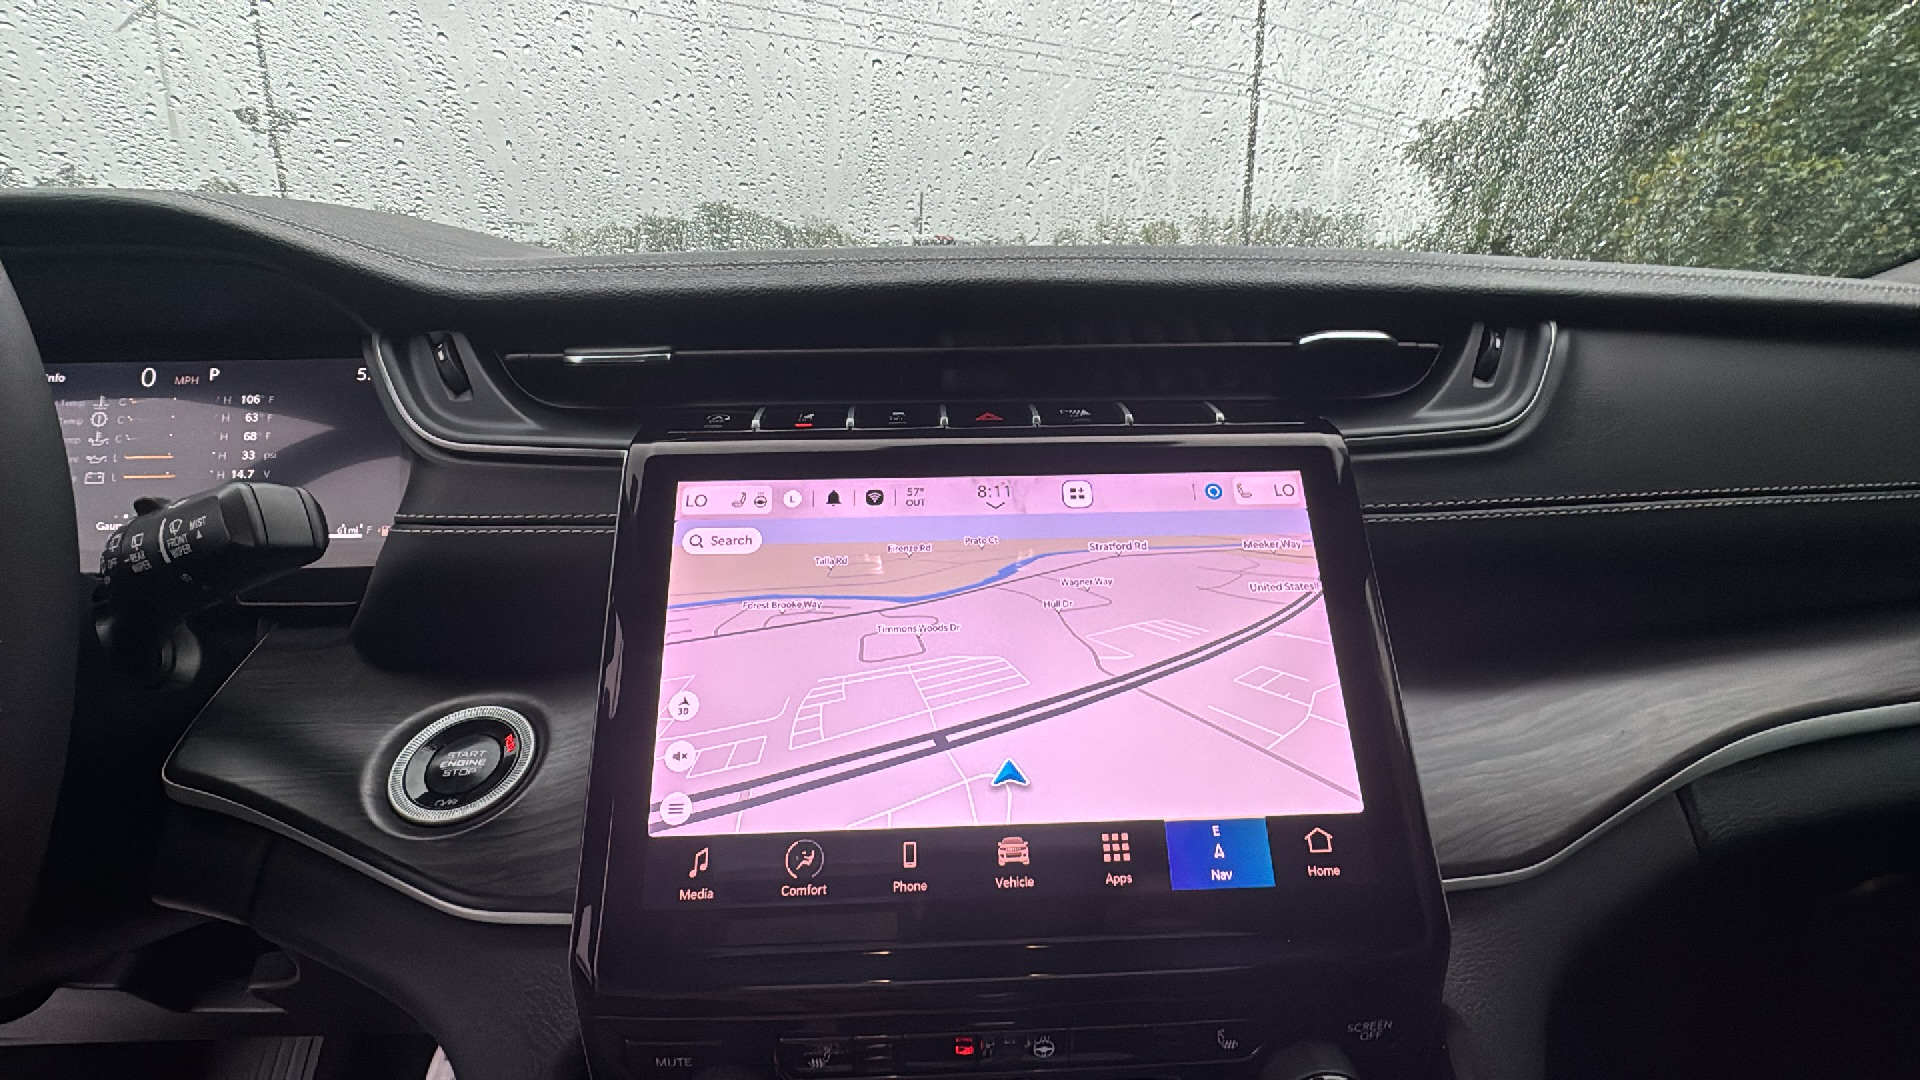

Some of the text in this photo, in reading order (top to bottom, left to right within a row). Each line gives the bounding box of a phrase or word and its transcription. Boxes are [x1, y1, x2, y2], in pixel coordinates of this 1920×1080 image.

[141, 367, 157, 388] 0
[209, 367, 221, 381] P
[174, 376, 200, 385] MPH
[241, 450, 255, 460] 33
[231, 469, 254, 479] 14.7
[977, 484, 1010, 498] 8:11
[1273, 483, 1295, 497] LO
[685, 493, 709, 508] LO
[905, 498, 926, 507] OUT
[189, 515, 207, 531] MIST
[366, 525, 373, 535] F
[166, 533, 188, 549] FRONT
[710, 534, 753, 547] Search
[988, 536, 999, 545] Ct
[1089, 541, 1147, 551] Stratford Rd
[1243, 539, 1302, 550] Meeker Way
[919, 544, 931, 553] Rd
[836, 556, 849, 566] Rd
[1061, 577, 1114, 588] Wagner Way
[1249, 583, 1283, 593] United
[1284, 582, 1315, 592] States
[742, 601, 769, 611] Forest
[802, 600, 822, 611] Way
[877, 623, 960, 634] Timmons Woods Dr
[447, 750, 487, 759] START
[439, 758, 487, 769] ENGINE
[441, 767, 477, 777] STOP
[1212, 825, 1220, 836] E
[1211, 868, 1233, 881] Nav
[1307, 865, 1341, 877] Home
[995, 875, 1035, 888] Vehicle
[1106, 872, 1133, 886] Apps
[781, 884, 827, 897] Comfort
[893, 881, 928, 893] Phone
[679, 888, 714, 900] Media
[1347, 1020, 1393, 1033] SCREEN
[1360, 1031, 1381, 1041] OFF
[655, 1057, 693, 1067] MUTE
